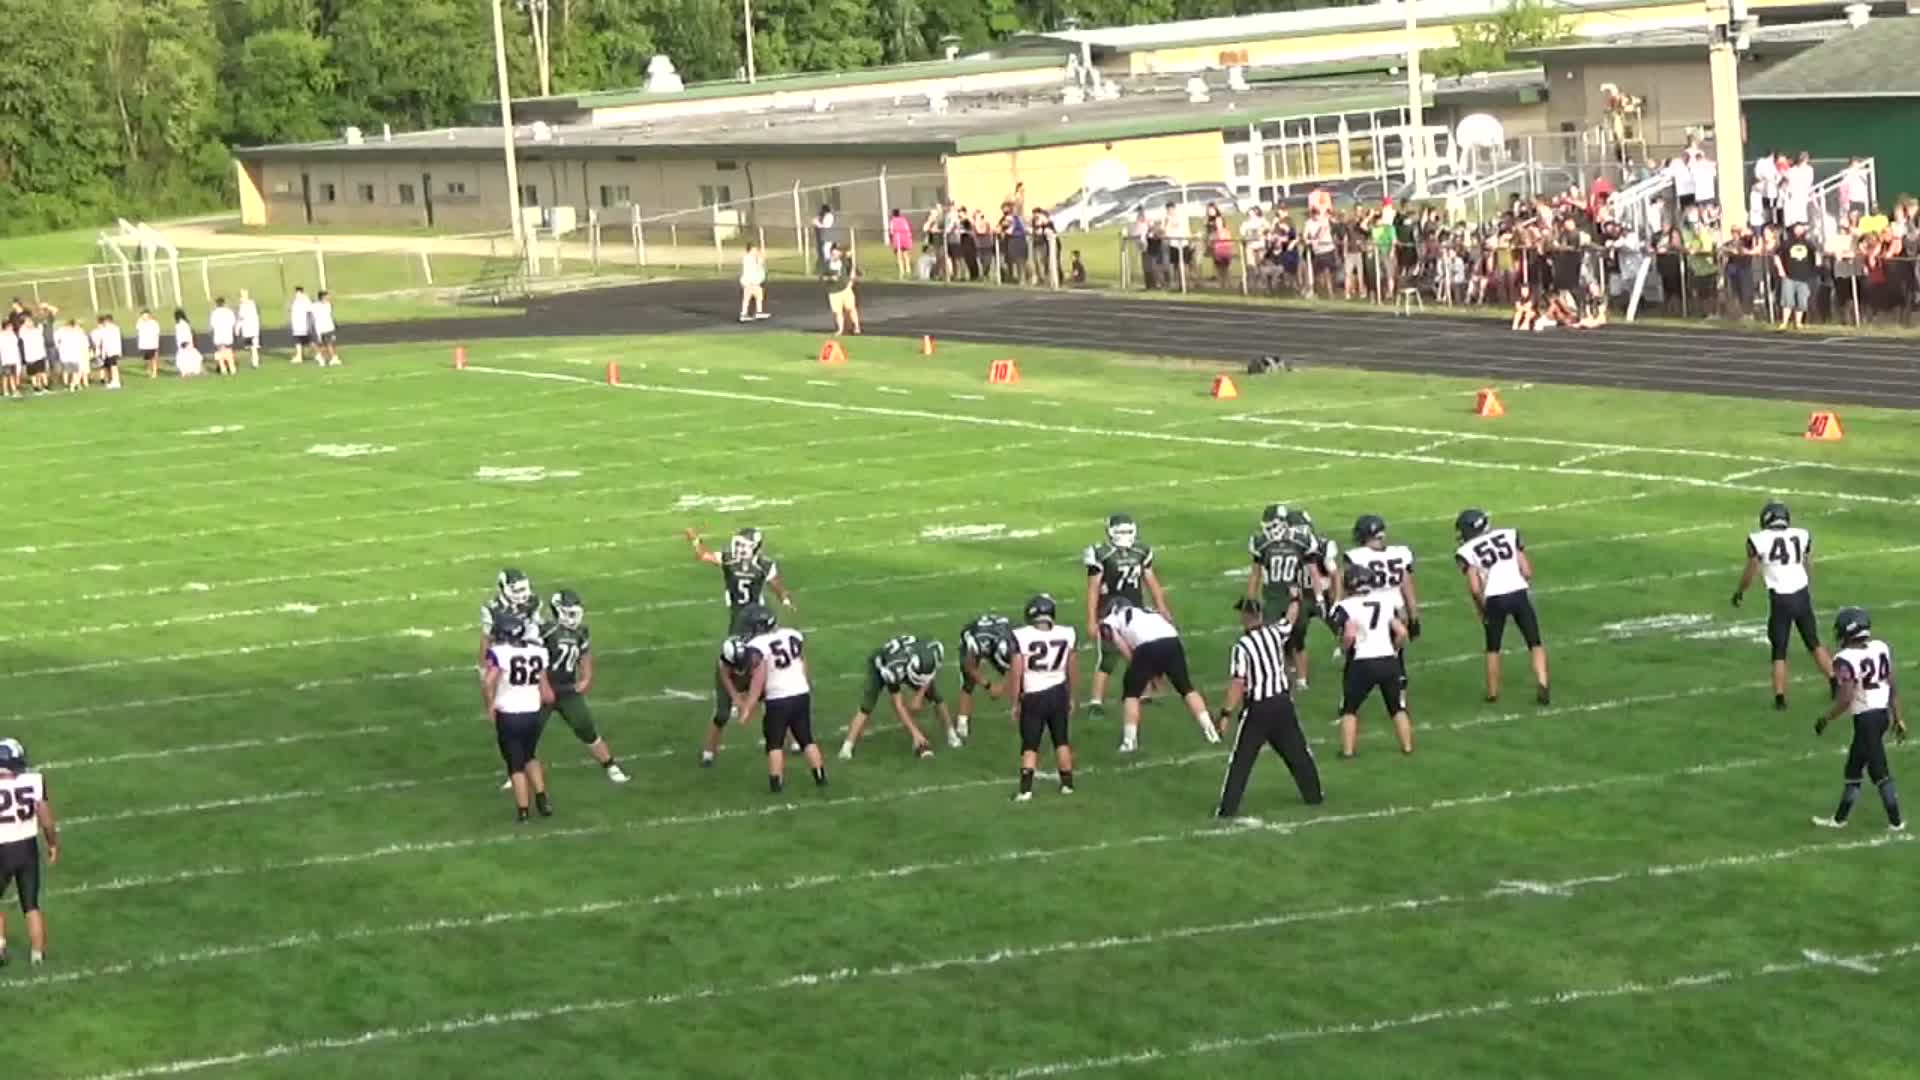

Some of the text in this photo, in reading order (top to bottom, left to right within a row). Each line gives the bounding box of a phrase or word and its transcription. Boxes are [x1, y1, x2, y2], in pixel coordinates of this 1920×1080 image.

[995, 363, 1009, 381] 10
[1473, 533, 1513, 569] 55
[1769, 536, 1801, 565] 41
[1116, 564, 1141, 591] 74
[1270, 554, 1298, 582] 00
[1367, 558, 1404, 589] 65
[738, 578, 752, 604] 5
[1362, 601, 1381, 630] 7
[509, 653, 543, 686] 62
[551, 642, 579, 672] 70
[1028, 639, 1068, 671] 27
[0, 785, 35, 823] 25
